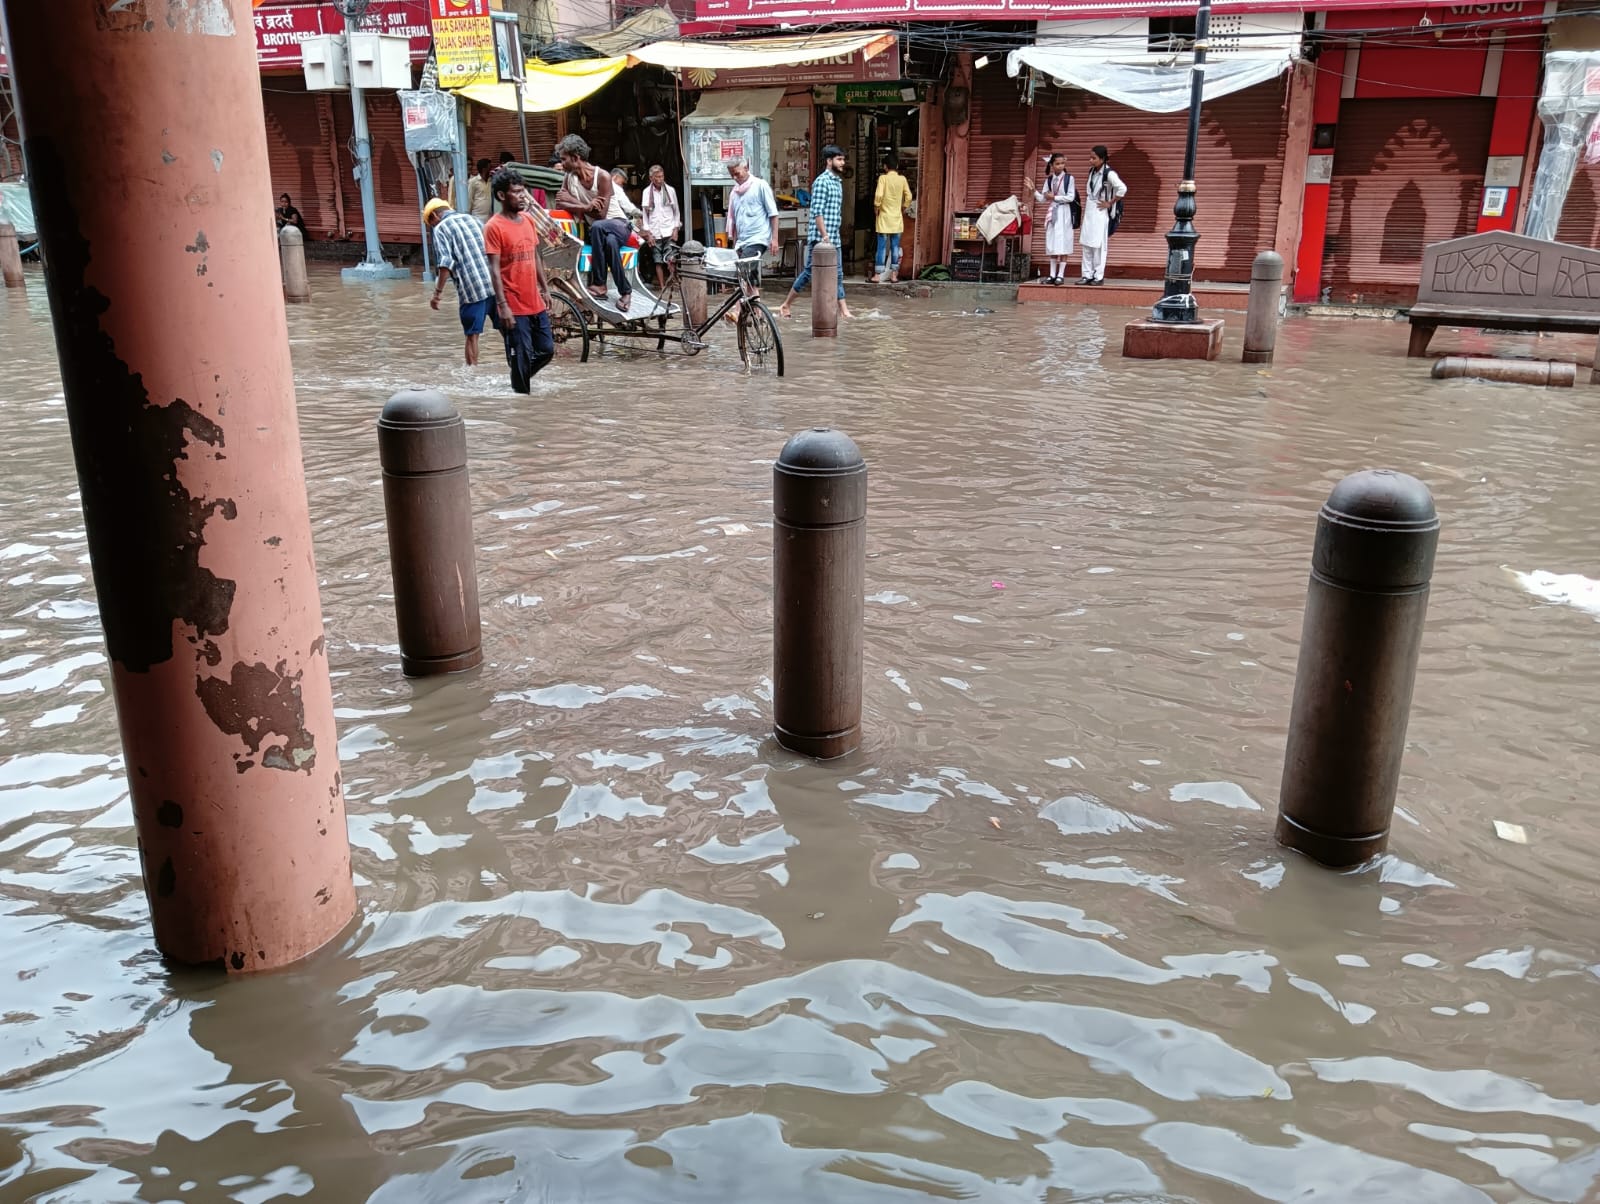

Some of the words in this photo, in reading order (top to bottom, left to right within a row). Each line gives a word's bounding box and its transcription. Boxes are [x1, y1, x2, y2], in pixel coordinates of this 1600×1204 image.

[265, 9, 294, 30] ब्रदर्स
[387, 13, 407, 25] SUIT
[388, 25, 431, 38] MATERIAL
[433, 20, 448, 33] MAA
[434, 35, 457, 50] PUJAN
[457, 34, 493, 48] SAMAGHRI
[845, 90, 869, 98] GIRLS
[872, 89, 900, 98] ORNE
